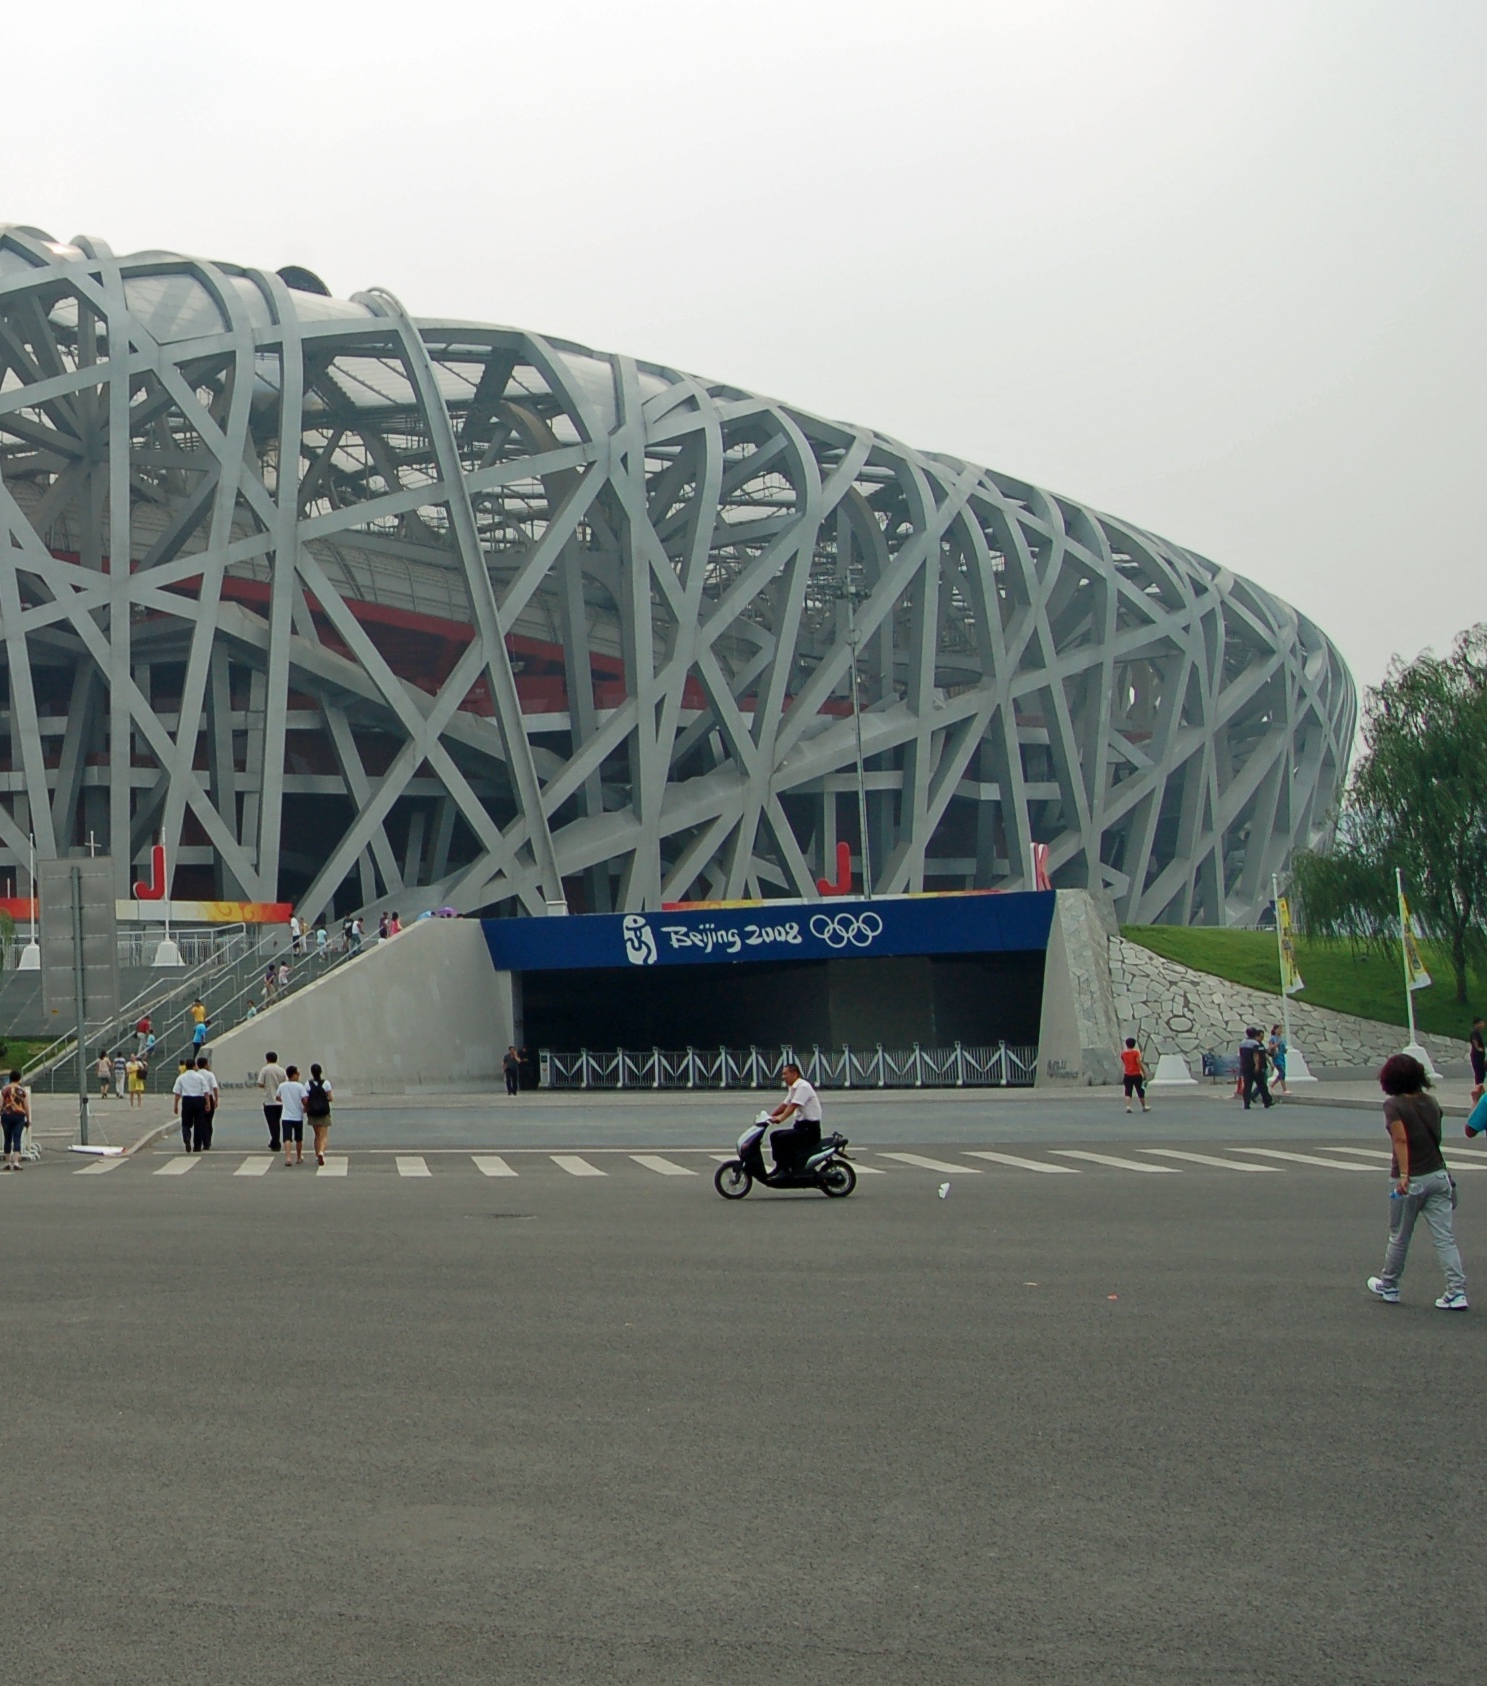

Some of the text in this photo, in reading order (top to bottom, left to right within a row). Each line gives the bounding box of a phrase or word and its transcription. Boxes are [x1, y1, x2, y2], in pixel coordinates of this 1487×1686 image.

[133, 844, 166, 900] J
[817, 841, 852, 897] J
[1029, 842, 1053, 892] K
[660, 922, 803, 953] Beijing 2008
